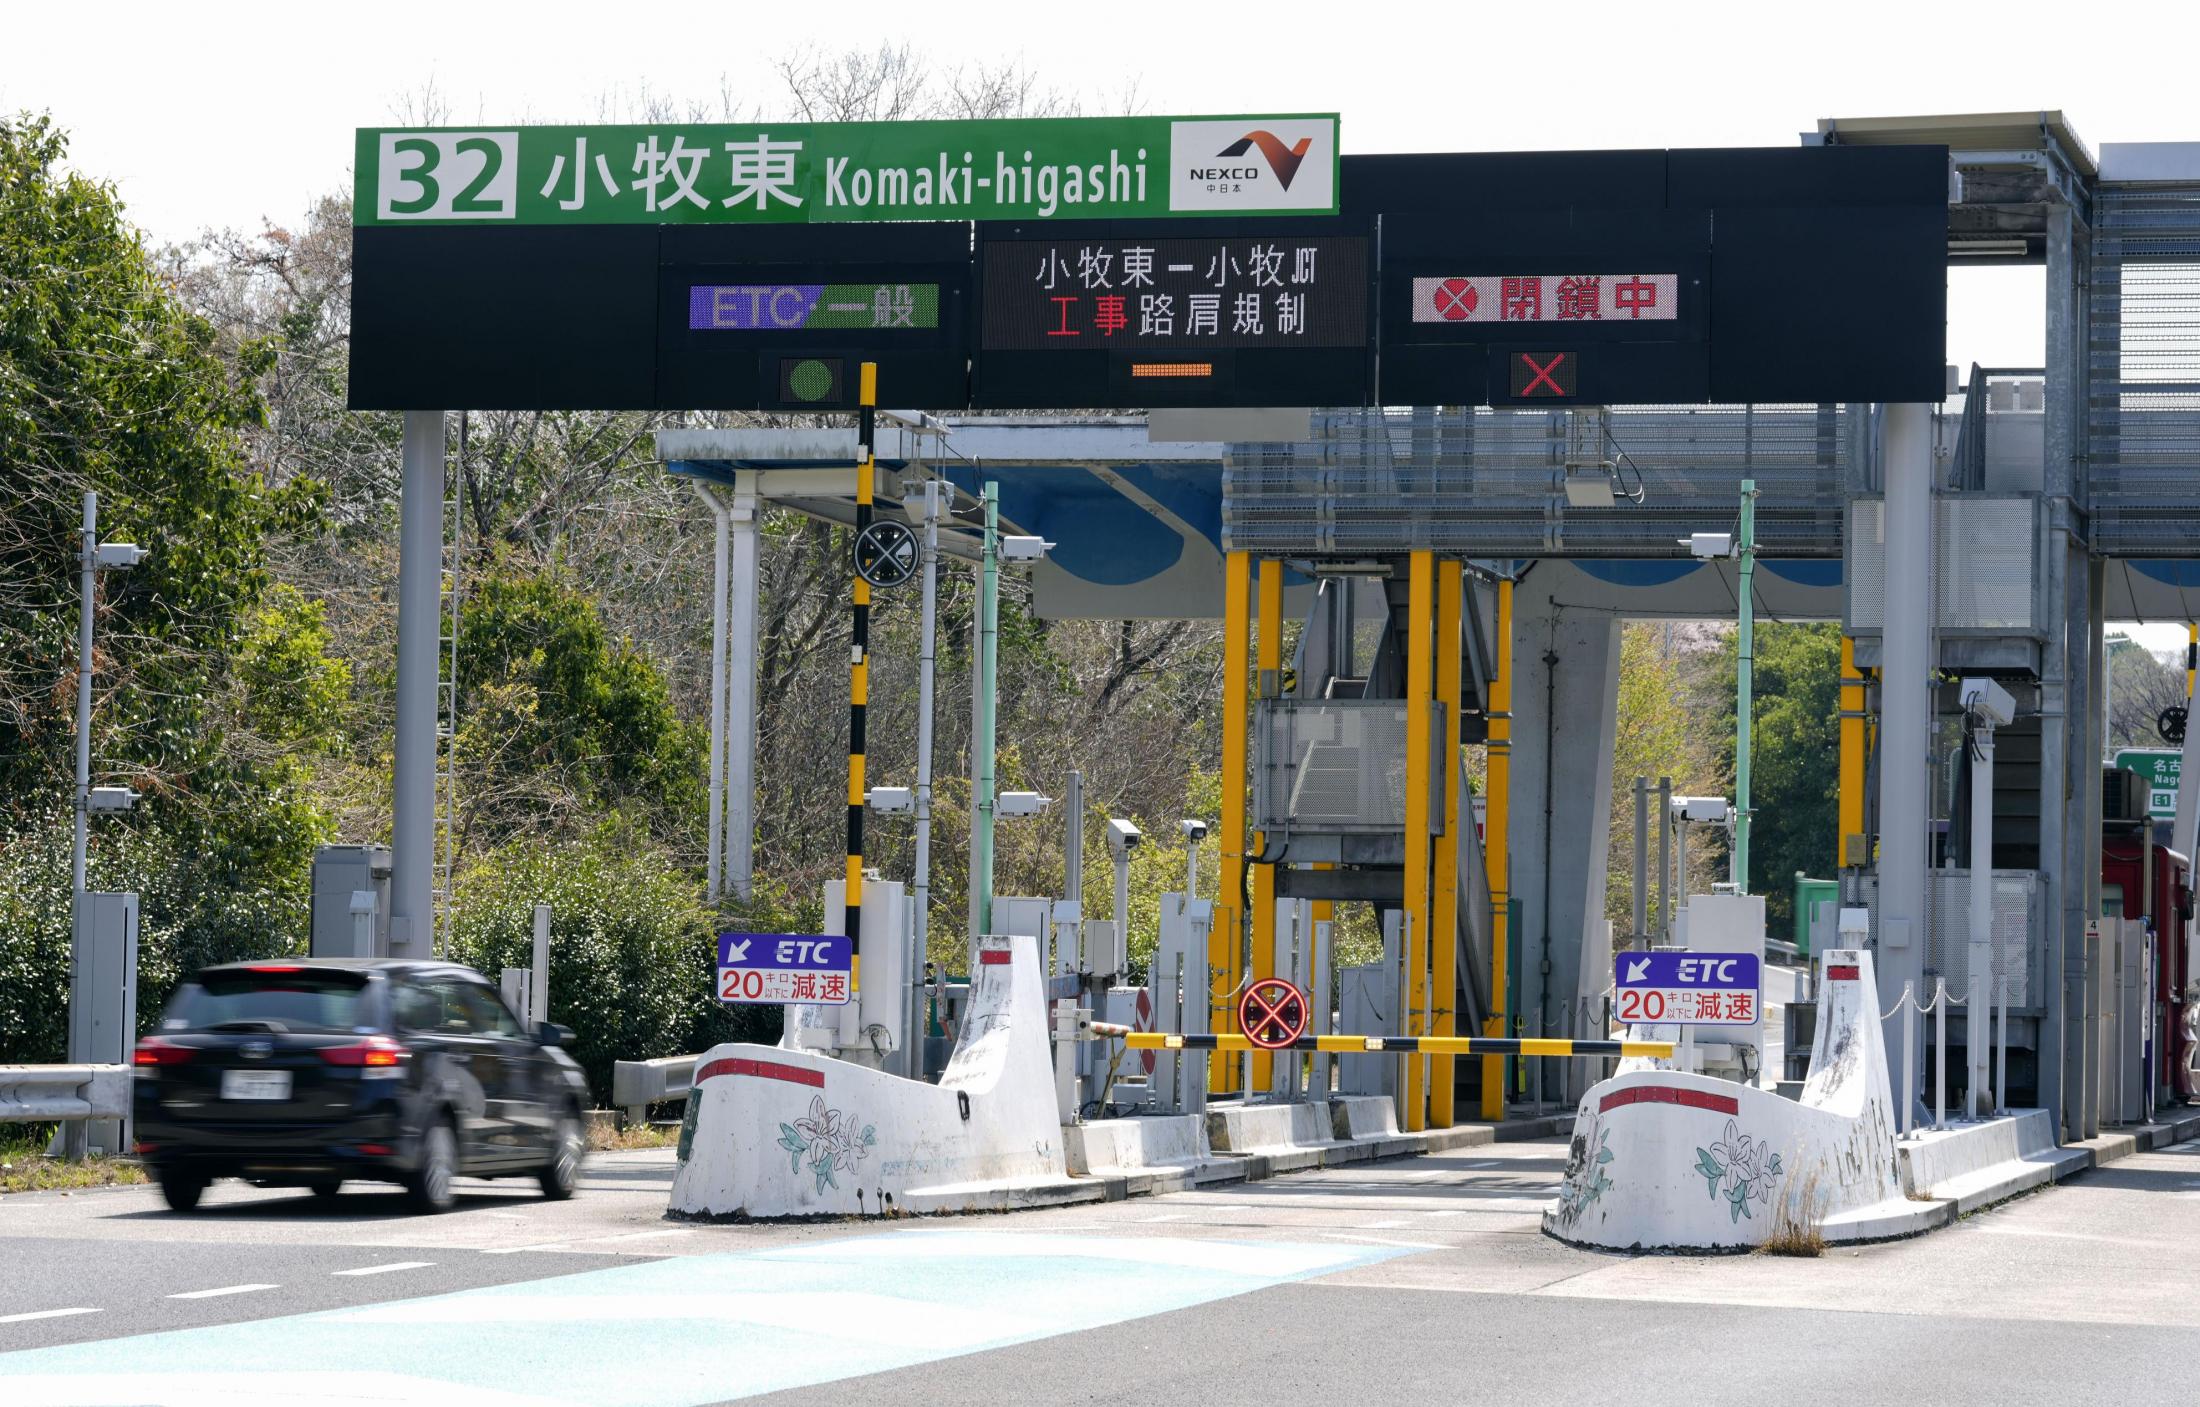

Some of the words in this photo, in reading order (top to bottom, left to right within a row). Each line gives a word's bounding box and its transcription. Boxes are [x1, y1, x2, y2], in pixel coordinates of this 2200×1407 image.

[389, 137, 504, 214] 32
[540, 133, 804, 213] 小牧東
[825, 148, 1147, 217] Komaki-higashi
[1190, 168, 1259, 180] NEXCO
[1206, 184, 1242, 193] 中日本
[1501, 275, 1656, 320] 閉鎖中
[2154, 795, 2168, 805] E1
[2090, 920, 2097, 930] 4
[775, 940, 832, 964] ETC
[765, 972, 789, 983] キロ
[1677, 959, 1738, 982] ETC
[722, 970, 764, 999] 20
[765, 988, 789, 999] 以下に
[791, 973, 845, 1001] 減速
[1621, 990, 1665, 1020] 20
[1667, 991, 1692, 1003] キロ
[1695, 992, 1753, 1020] 減速
[1667, 1008, 1692, 1019] 以下に
